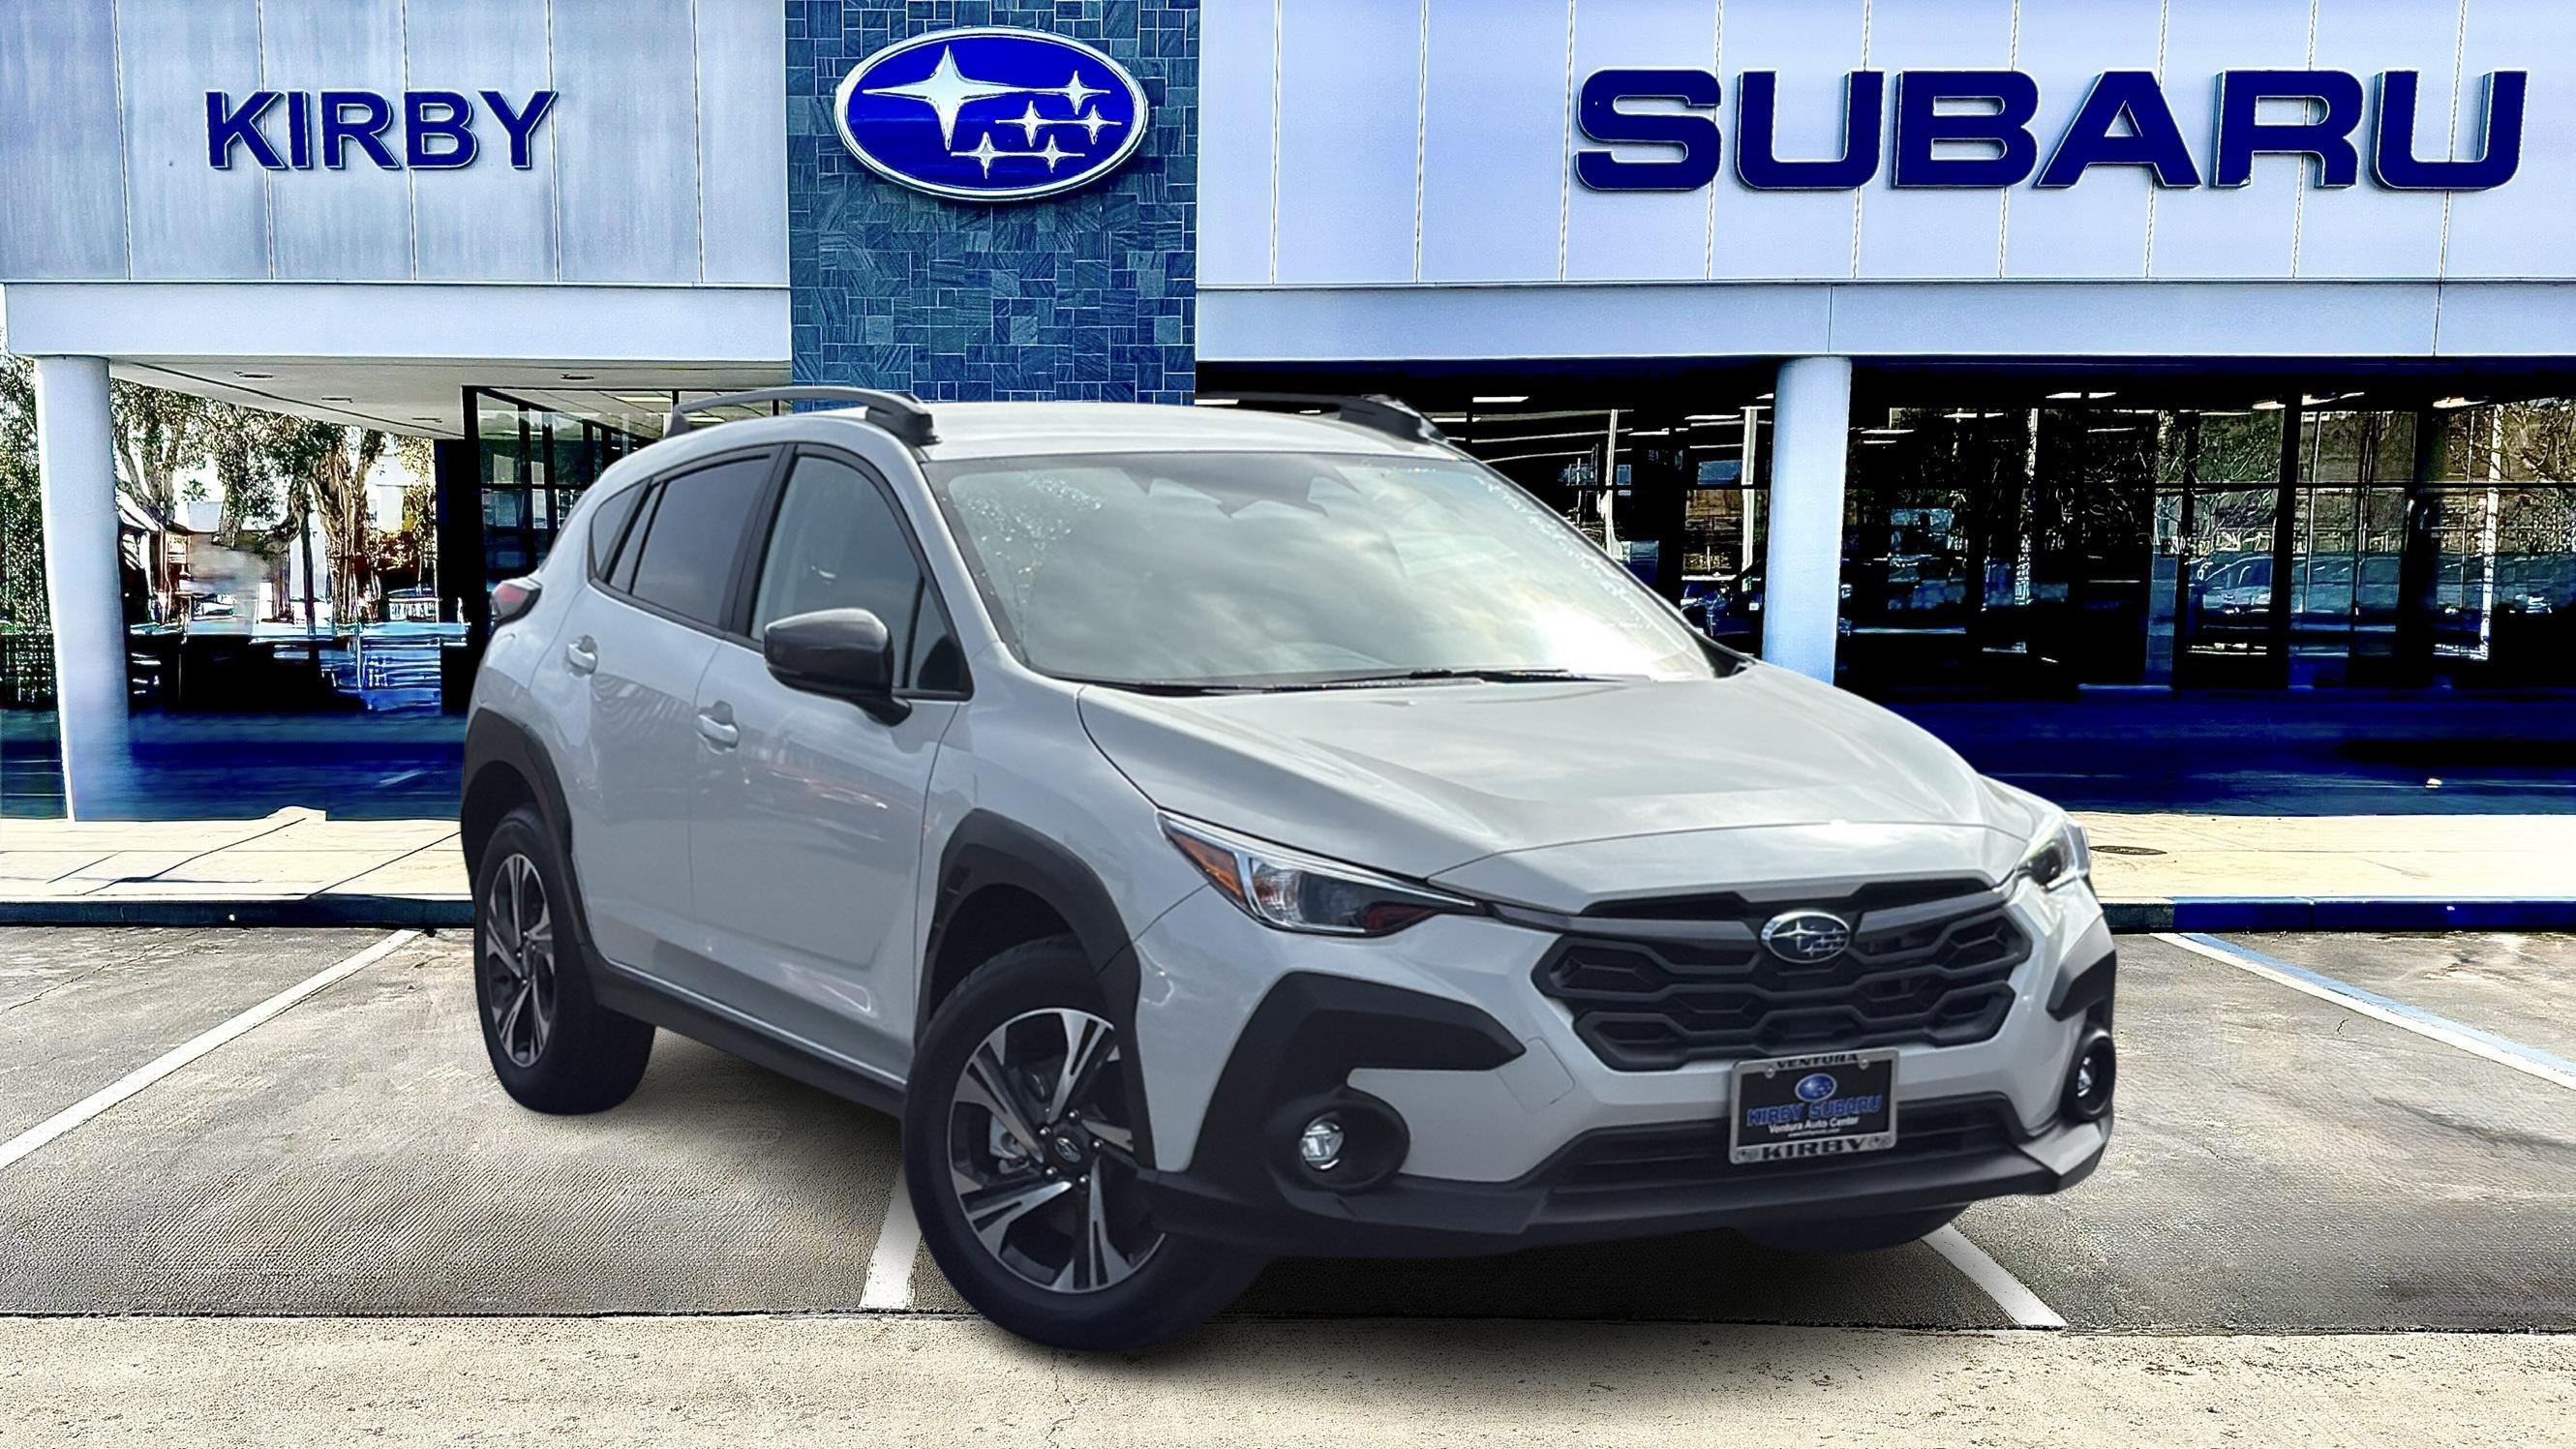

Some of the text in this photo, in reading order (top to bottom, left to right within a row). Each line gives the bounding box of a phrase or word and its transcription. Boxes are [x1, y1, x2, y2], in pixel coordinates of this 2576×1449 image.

[205, 90, 559, 169] KIRBY
[1575, 69, 2528, 191] SUBARU
[1778, 1054, 1859, 1069] VENTURA
[1746, 1095, 1883, 1127] KIRBY SUBARU
[1768, 1122, 1803, 1133] Ventura
[1804, 1119, 1828, 1130] Auto
[1830, 1116, 1860, 1129] Center
[1762, 1138, 1866, 1160] KIRBY
